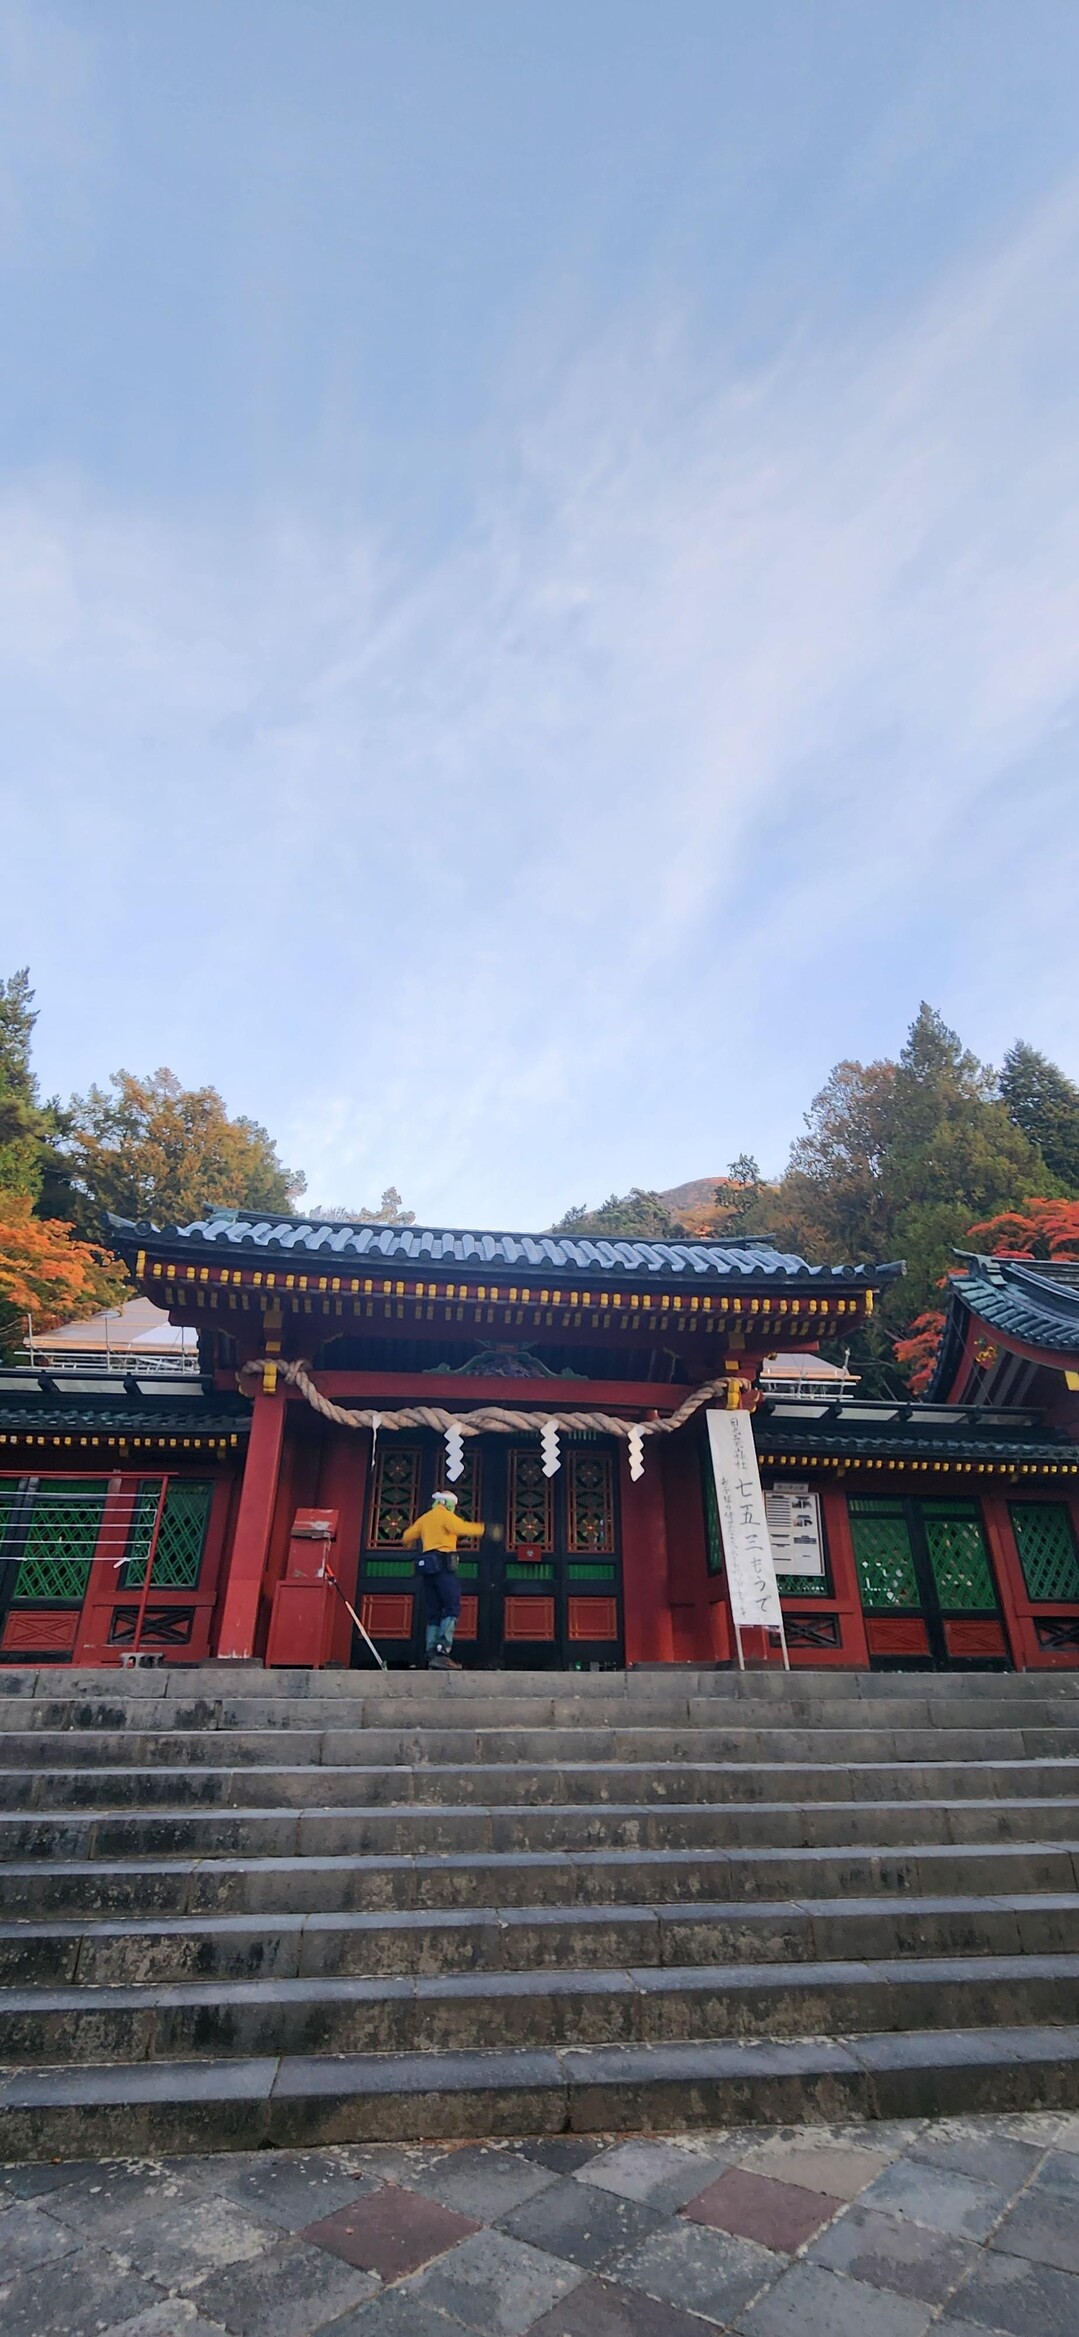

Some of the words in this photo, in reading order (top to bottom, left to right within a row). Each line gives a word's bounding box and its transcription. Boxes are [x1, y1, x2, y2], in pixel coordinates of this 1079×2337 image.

[735, 1478, 772, 1613] 七五三もうで
